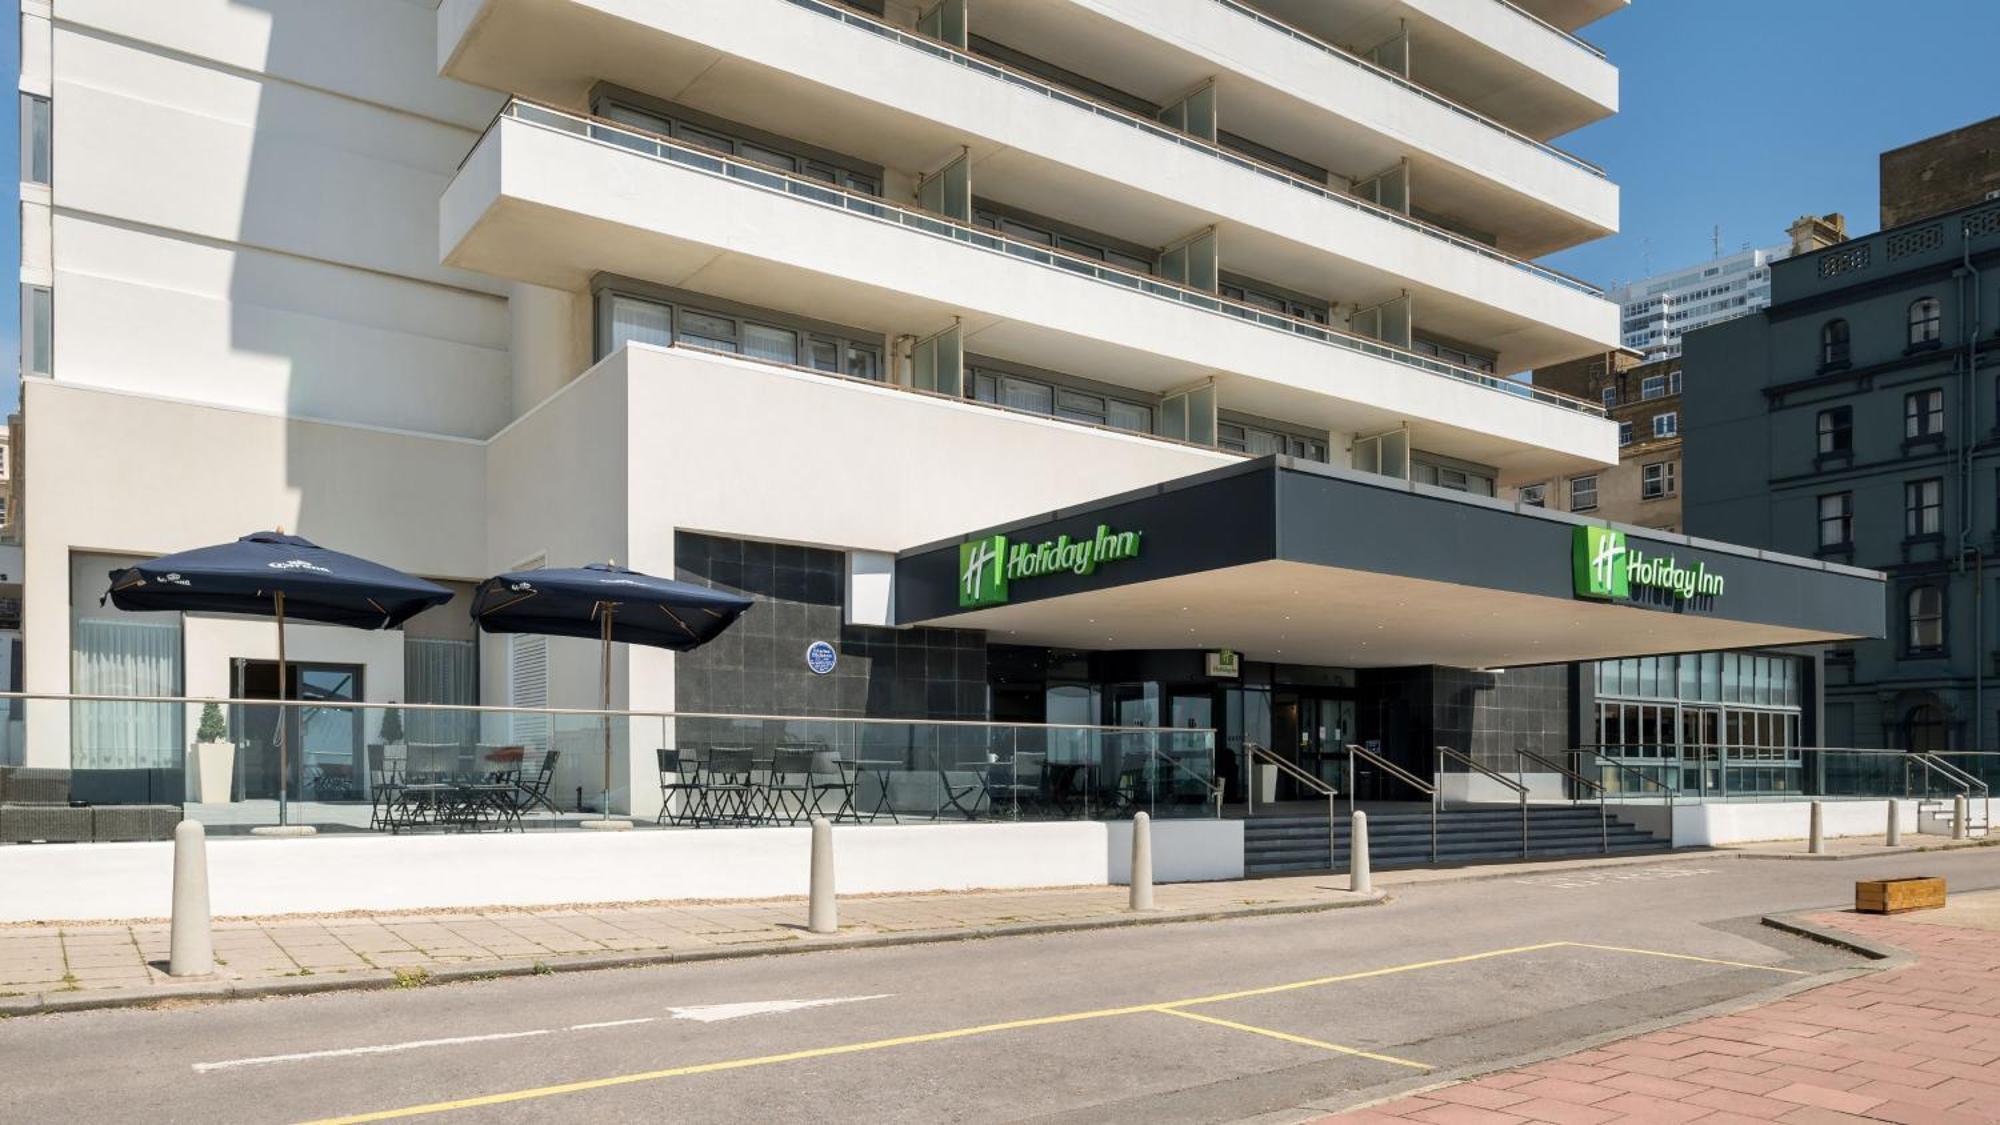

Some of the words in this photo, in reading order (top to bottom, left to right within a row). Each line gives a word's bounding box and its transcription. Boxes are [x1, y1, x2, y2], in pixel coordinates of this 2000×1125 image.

[1007, 536, 1093, 578] Holiday
[1094, 525, 1139, 561] Inn
[1627, 550, 1697, 598] Holiday
[1698, 562, 1725, 596] Inn
